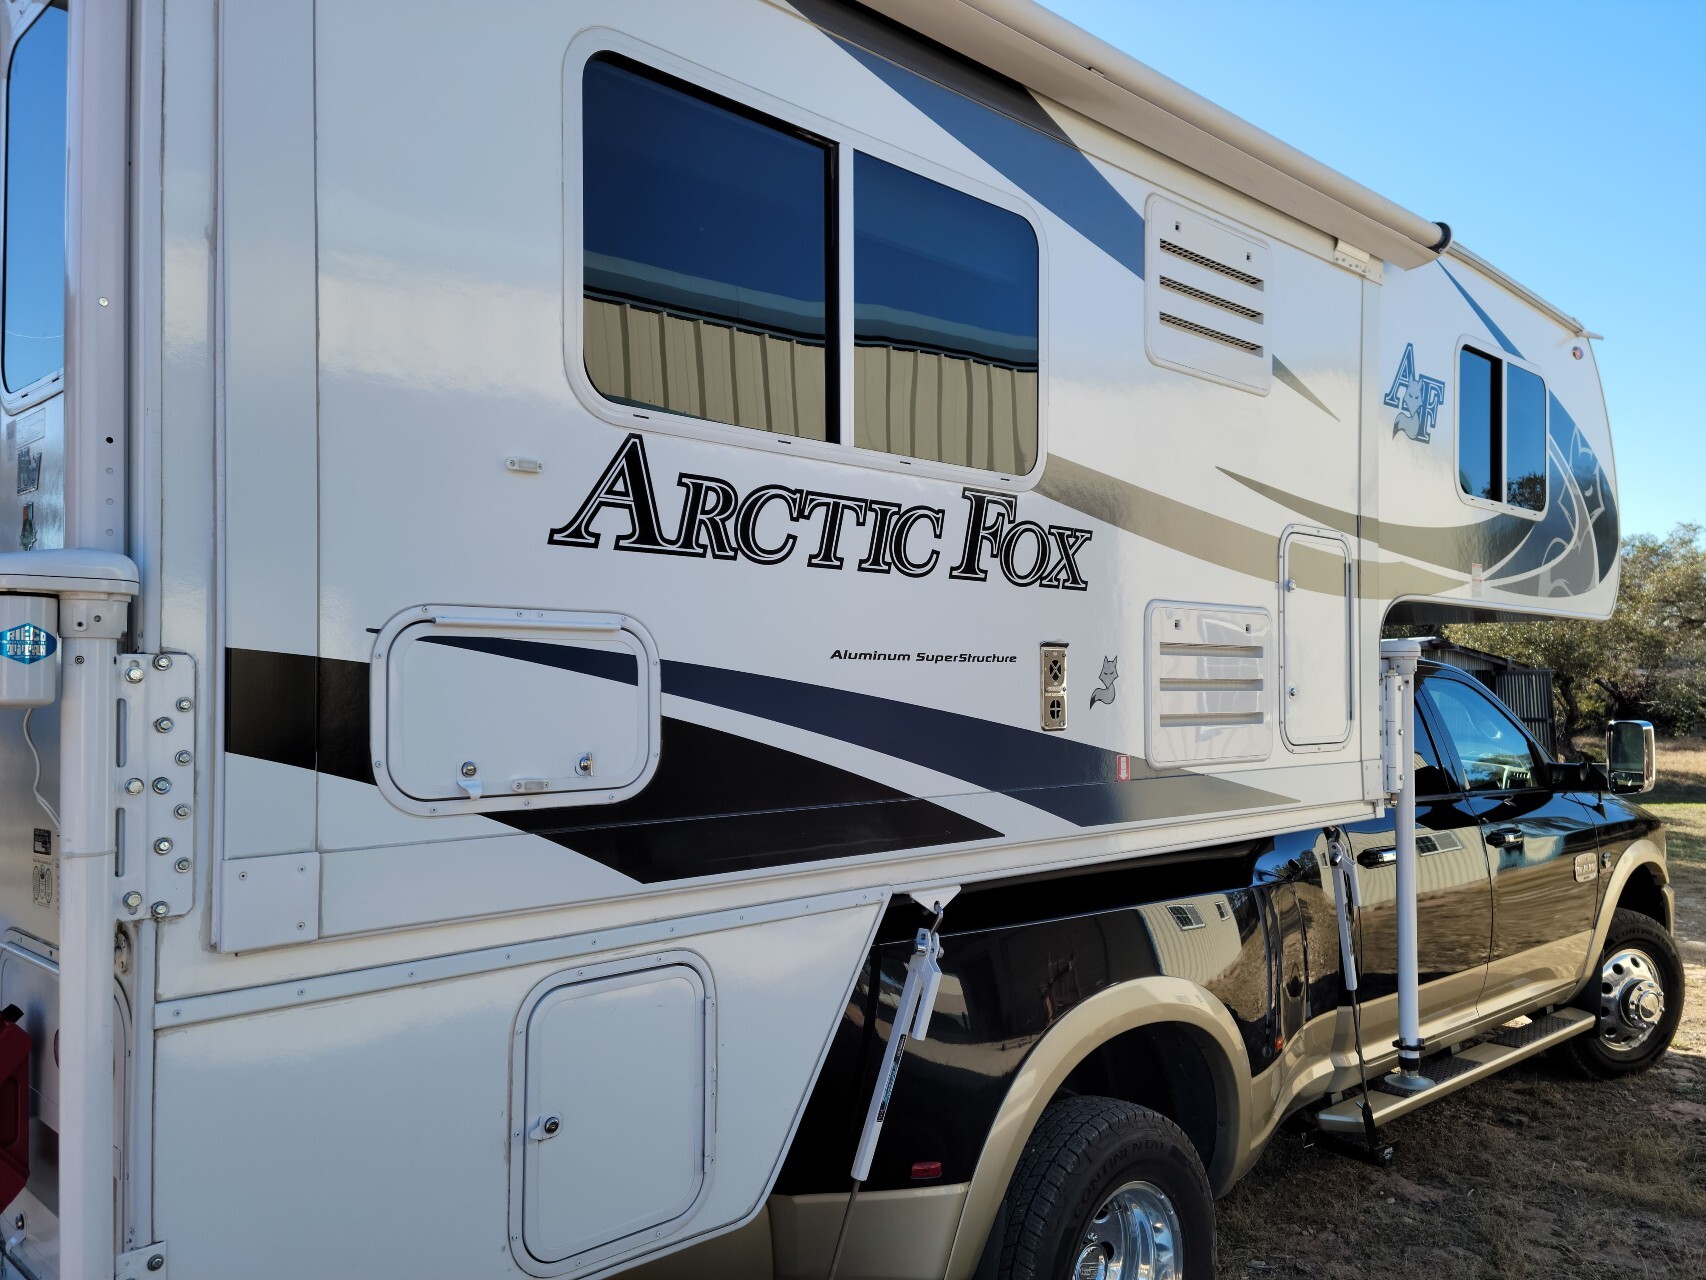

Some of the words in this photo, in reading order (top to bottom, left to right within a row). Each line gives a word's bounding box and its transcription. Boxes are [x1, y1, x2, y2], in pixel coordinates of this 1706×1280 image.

[547, 433, 944, 577] ARCTIC
[949, 487, 1092, 590] FOX
[830, 649, 911, 662] Aluminum
[916, 652, 1017, 664] SuperStructure
[1074, 1139, 1166, 1219] CONTINENTAL
